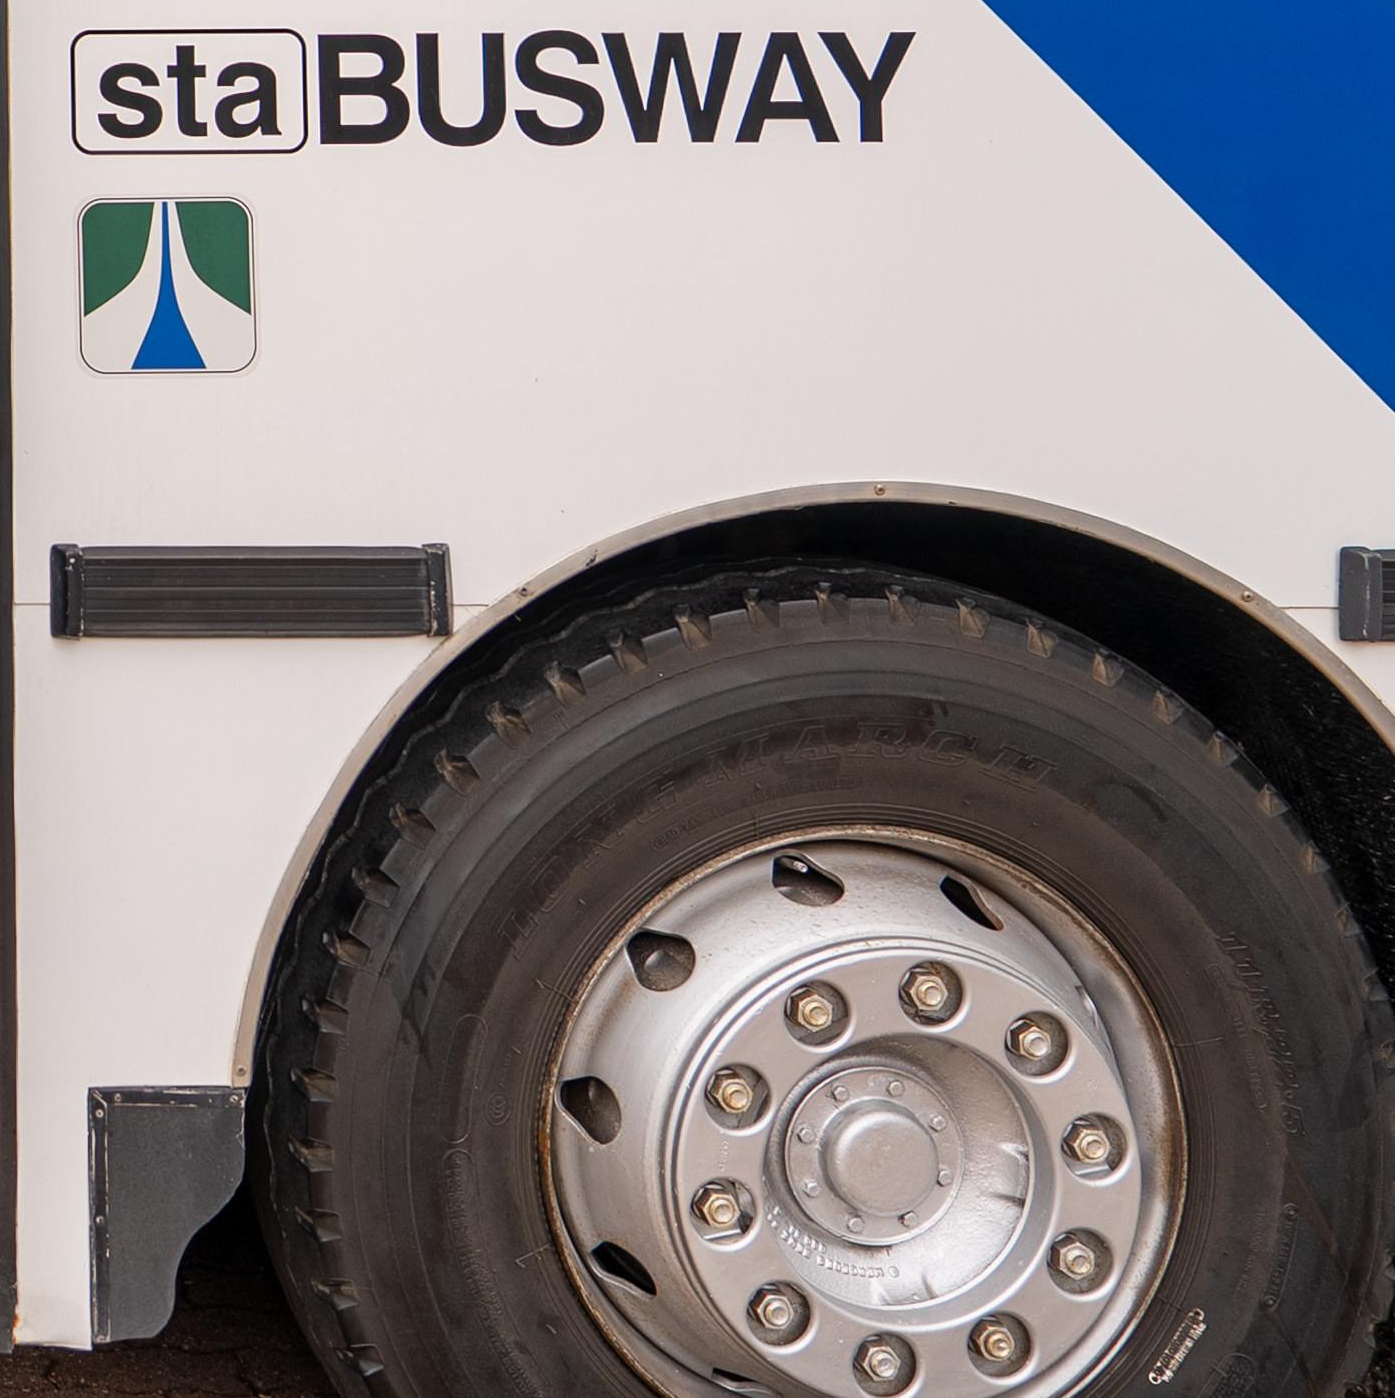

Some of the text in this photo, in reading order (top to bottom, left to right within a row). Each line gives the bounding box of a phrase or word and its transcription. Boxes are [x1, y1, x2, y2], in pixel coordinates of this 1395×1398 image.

[97, 29, 917, 147] sta BUSWAY
[497, 722, 1059, 961] LONG MARCH
